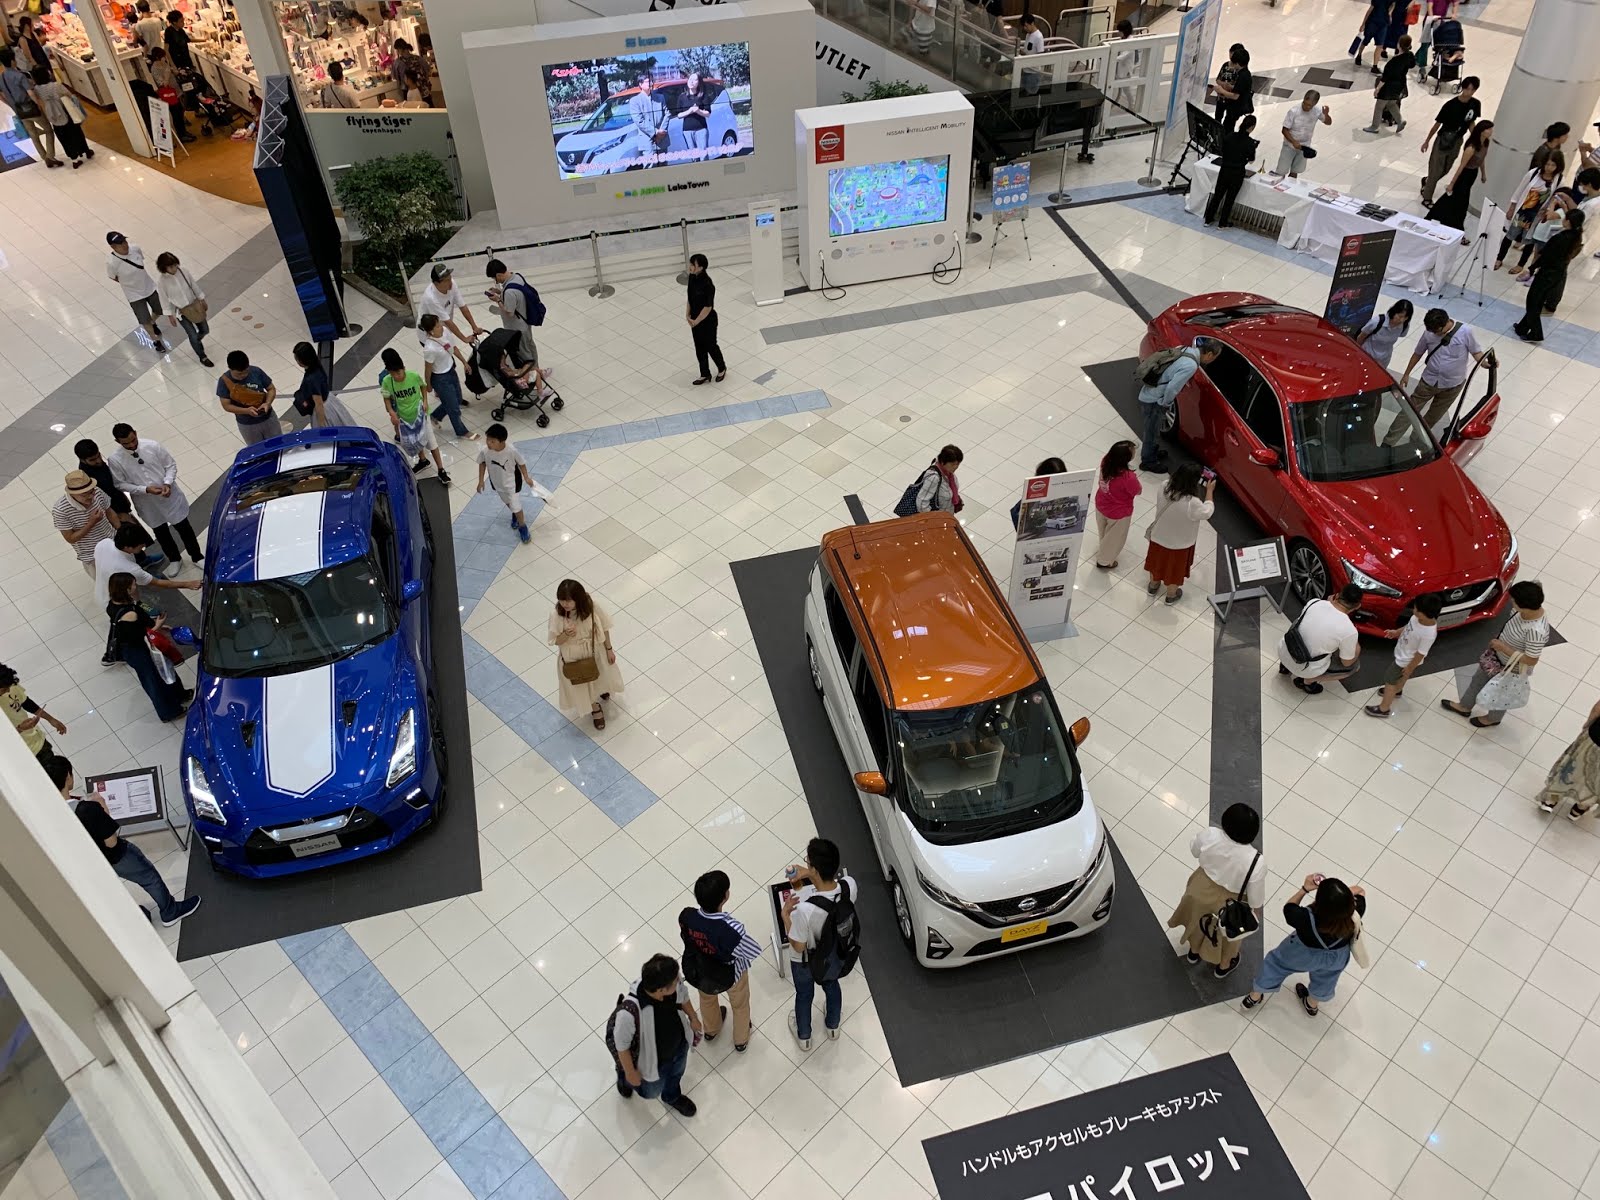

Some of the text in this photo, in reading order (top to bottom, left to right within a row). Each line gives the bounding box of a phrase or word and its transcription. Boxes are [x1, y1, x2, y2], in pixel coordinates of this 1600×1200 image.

[815, 40, 871, 80] UTLET
[346, 115, 412, 128] flying tiger
[940, 121, 967, 129] MOBILITY
[667, 181, 710, 192] LakeTown
[394, 386, 416, 398] MERGE
[296, 840, 336, 853] NISSAN
[1010, 924, 1040, 936] DAYZ
[962, 1087, 1223, 1176] ハンドルもアクセルもブレーキもアシスト
[1024, 1136, 1249, 1200] パイロット
